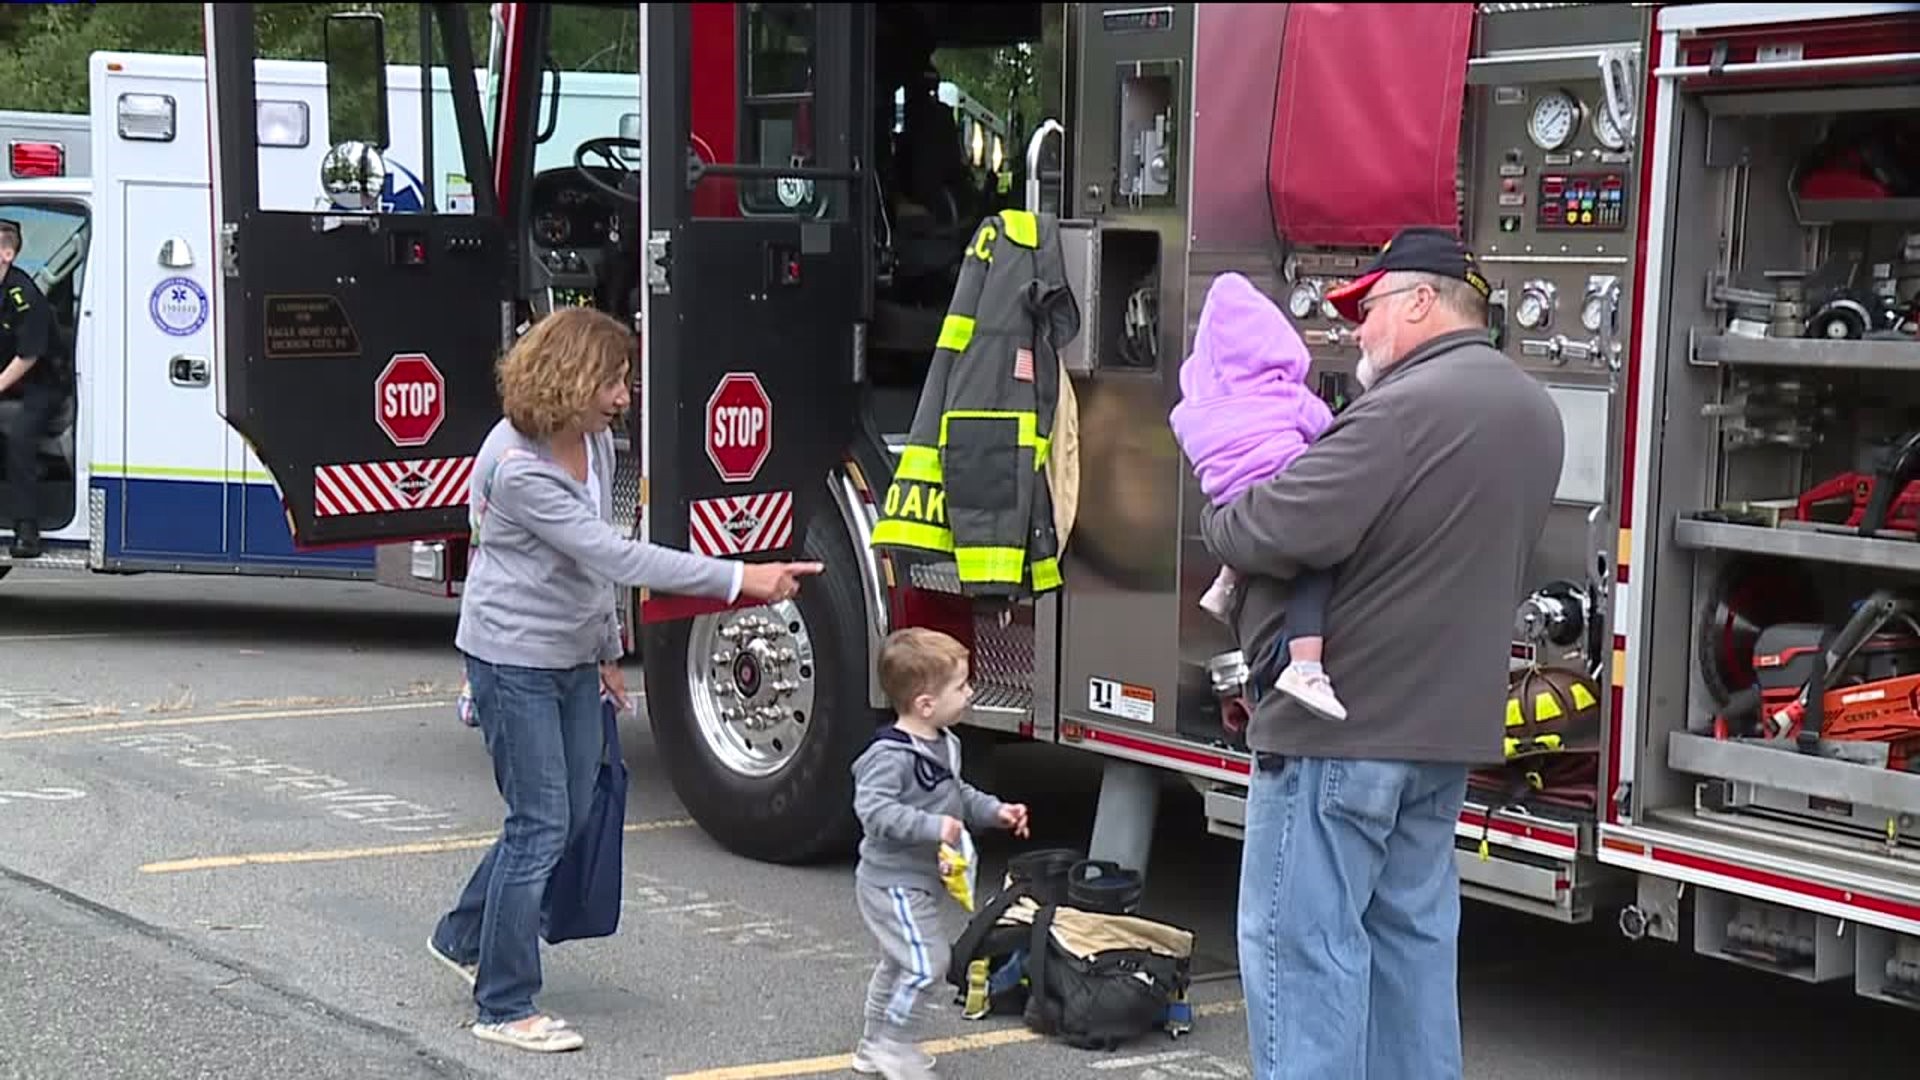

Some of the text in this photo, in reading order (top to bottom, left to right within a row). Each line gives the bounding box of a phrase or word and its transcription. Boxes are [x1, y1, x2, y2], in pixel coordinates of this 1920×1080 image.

[384, 381, 437, 418] STOP
[714, 405, 764, 448] STOP
[884, 483, 945, 524] OAK
